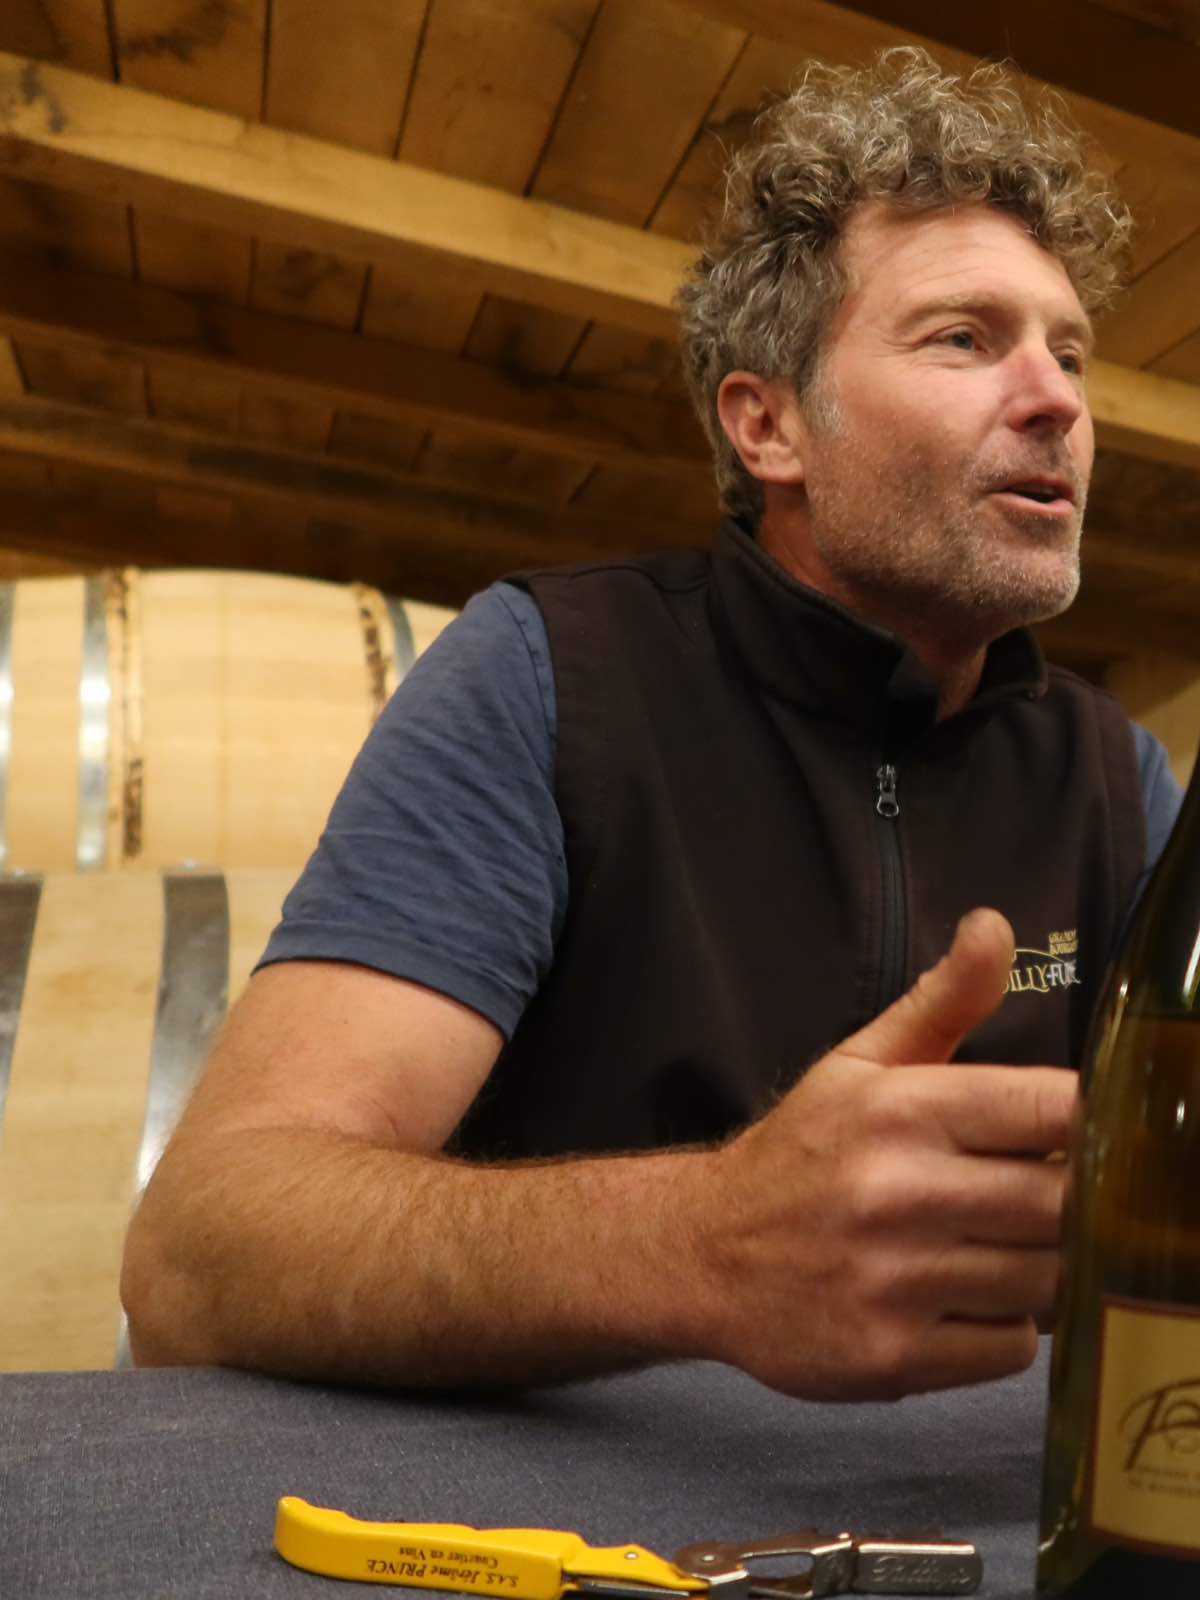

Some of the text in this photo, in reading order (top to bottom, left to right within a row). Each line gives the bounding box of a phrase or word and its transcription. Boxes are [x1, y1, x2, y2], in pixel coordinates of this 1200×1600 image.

[399, 1547, 427, 1561] Vins
[430, 1549, 444, 1560] en
[367, 1559, 428, 1578] PRINCE
